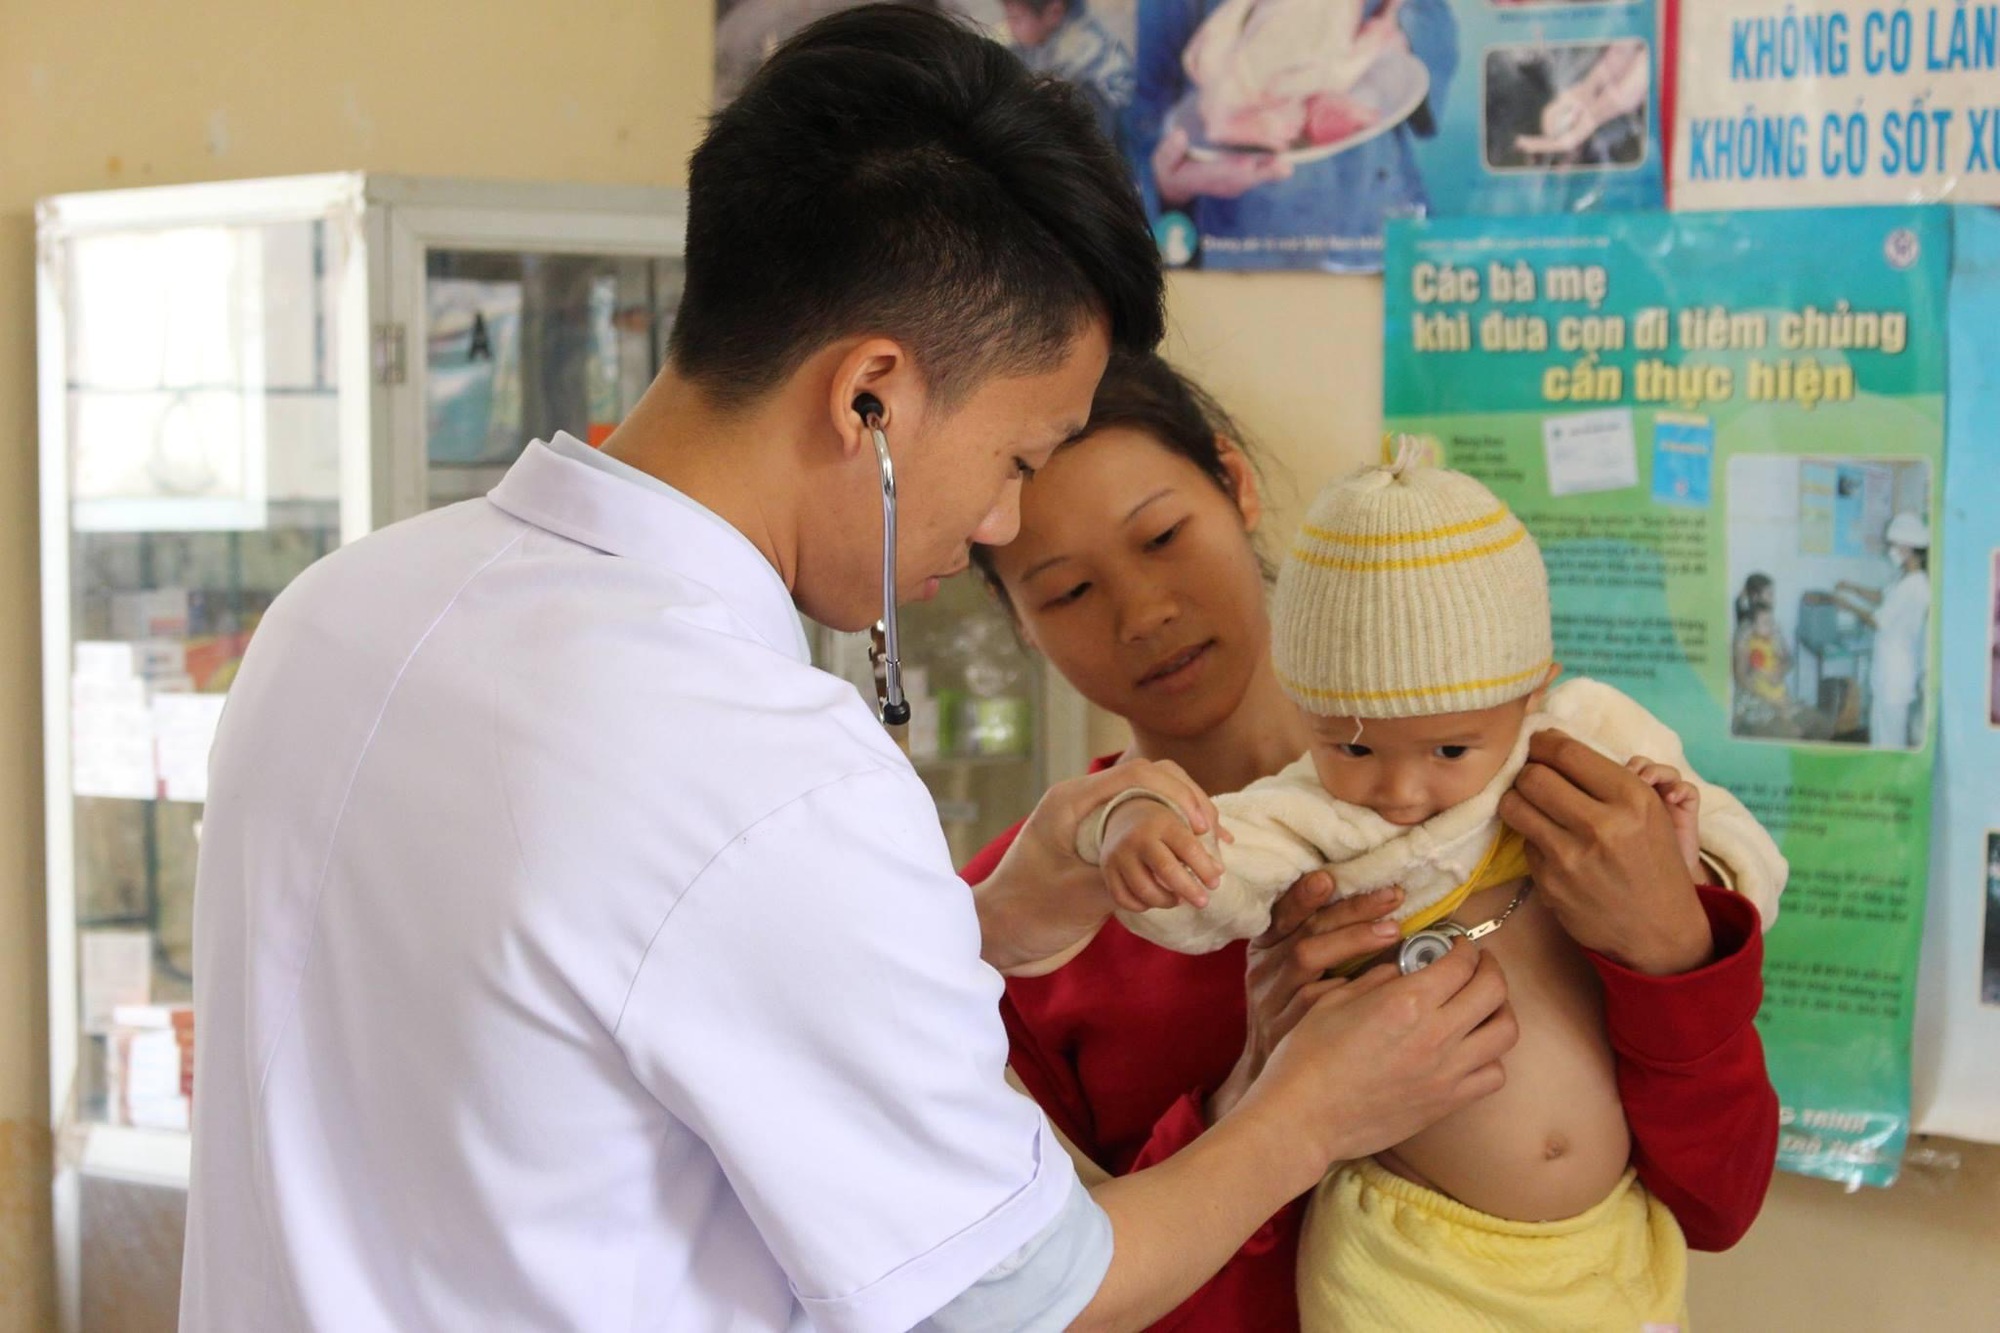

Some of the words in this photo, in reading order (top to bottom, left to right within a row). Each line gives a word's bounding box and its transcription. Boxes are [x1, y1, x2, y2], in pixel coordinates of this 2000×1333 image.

[1731, 4, 1849, 80] KHÔNG
[1690, 103, 1808, 181] KHÔNG
[1821, 95, 1868, 178] CÓ
[1881, 88, 1953, 177] SỐT
[1412, 258, 1481, 302] Các
[1488, 258, 1537, 302] bà
[1545, 264, 1608, 310] mẹ
[1413, 310, 1471, 351] khi
[1634, 306, 1669, 350] đi
[1679, 304, 1767, 350] tiêm
[1780, 297, 1907, 354] chủng
[1634, 358, 1734, 410] thực
[1747, 356, 1854, 410] hiện
